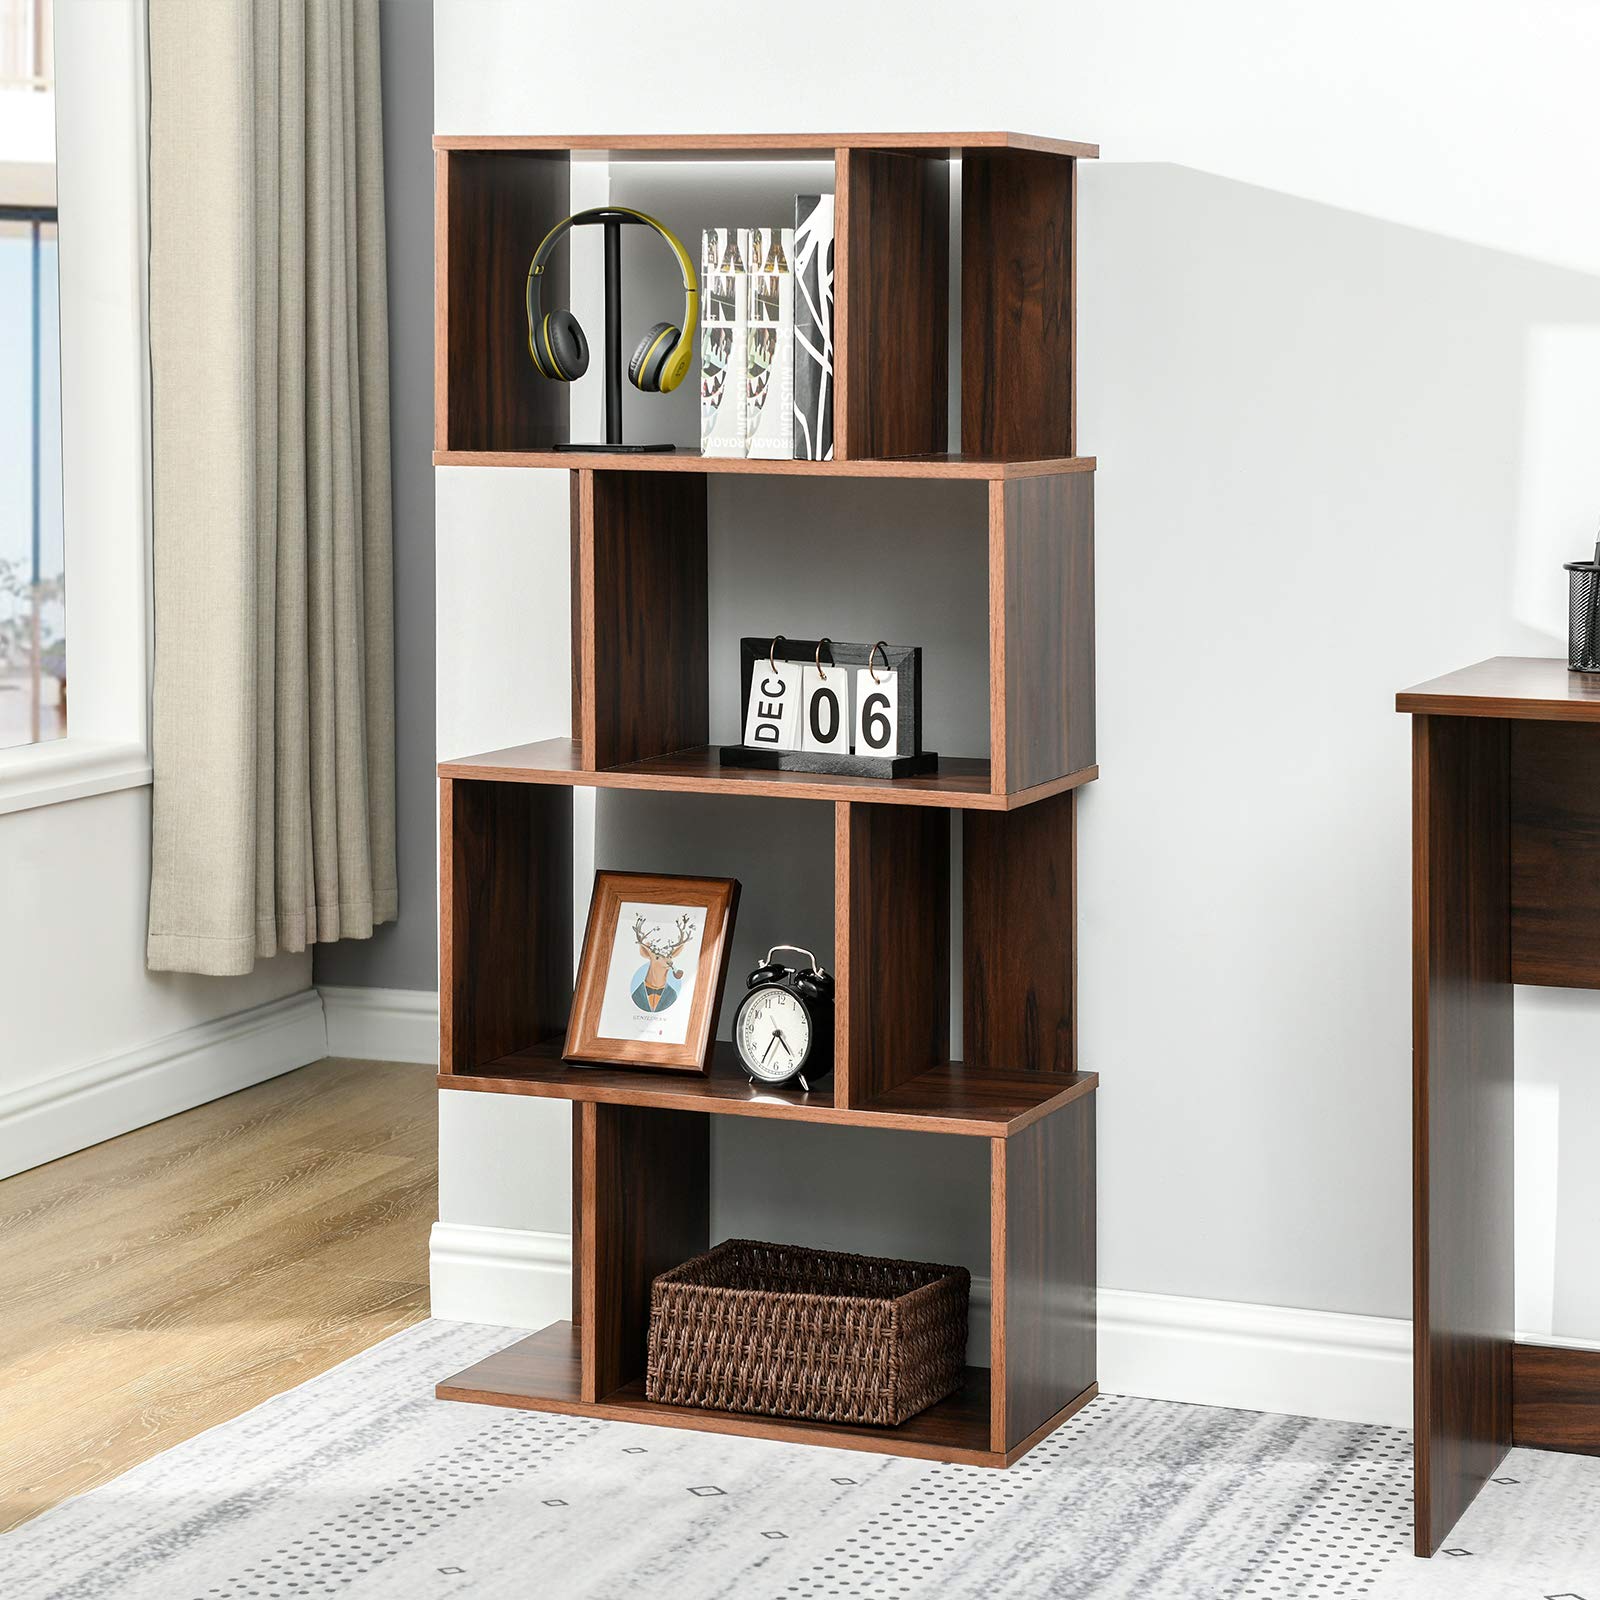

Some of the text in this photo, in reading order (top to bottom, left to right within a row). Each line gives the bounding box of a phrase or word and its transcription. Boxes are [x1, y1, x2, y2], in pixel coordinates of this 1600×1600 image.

[780, 366, 793, 436] MUSEUM
[754, 678, 786, 743] DEC
[765, 999, 771, 1009] 11
[777, 995, 786, 1005] 12
[755, 1009, 762, 1019] 10
[748, 1024, 754, 1034] 9
[773, 1061, 779, 1071] 6
